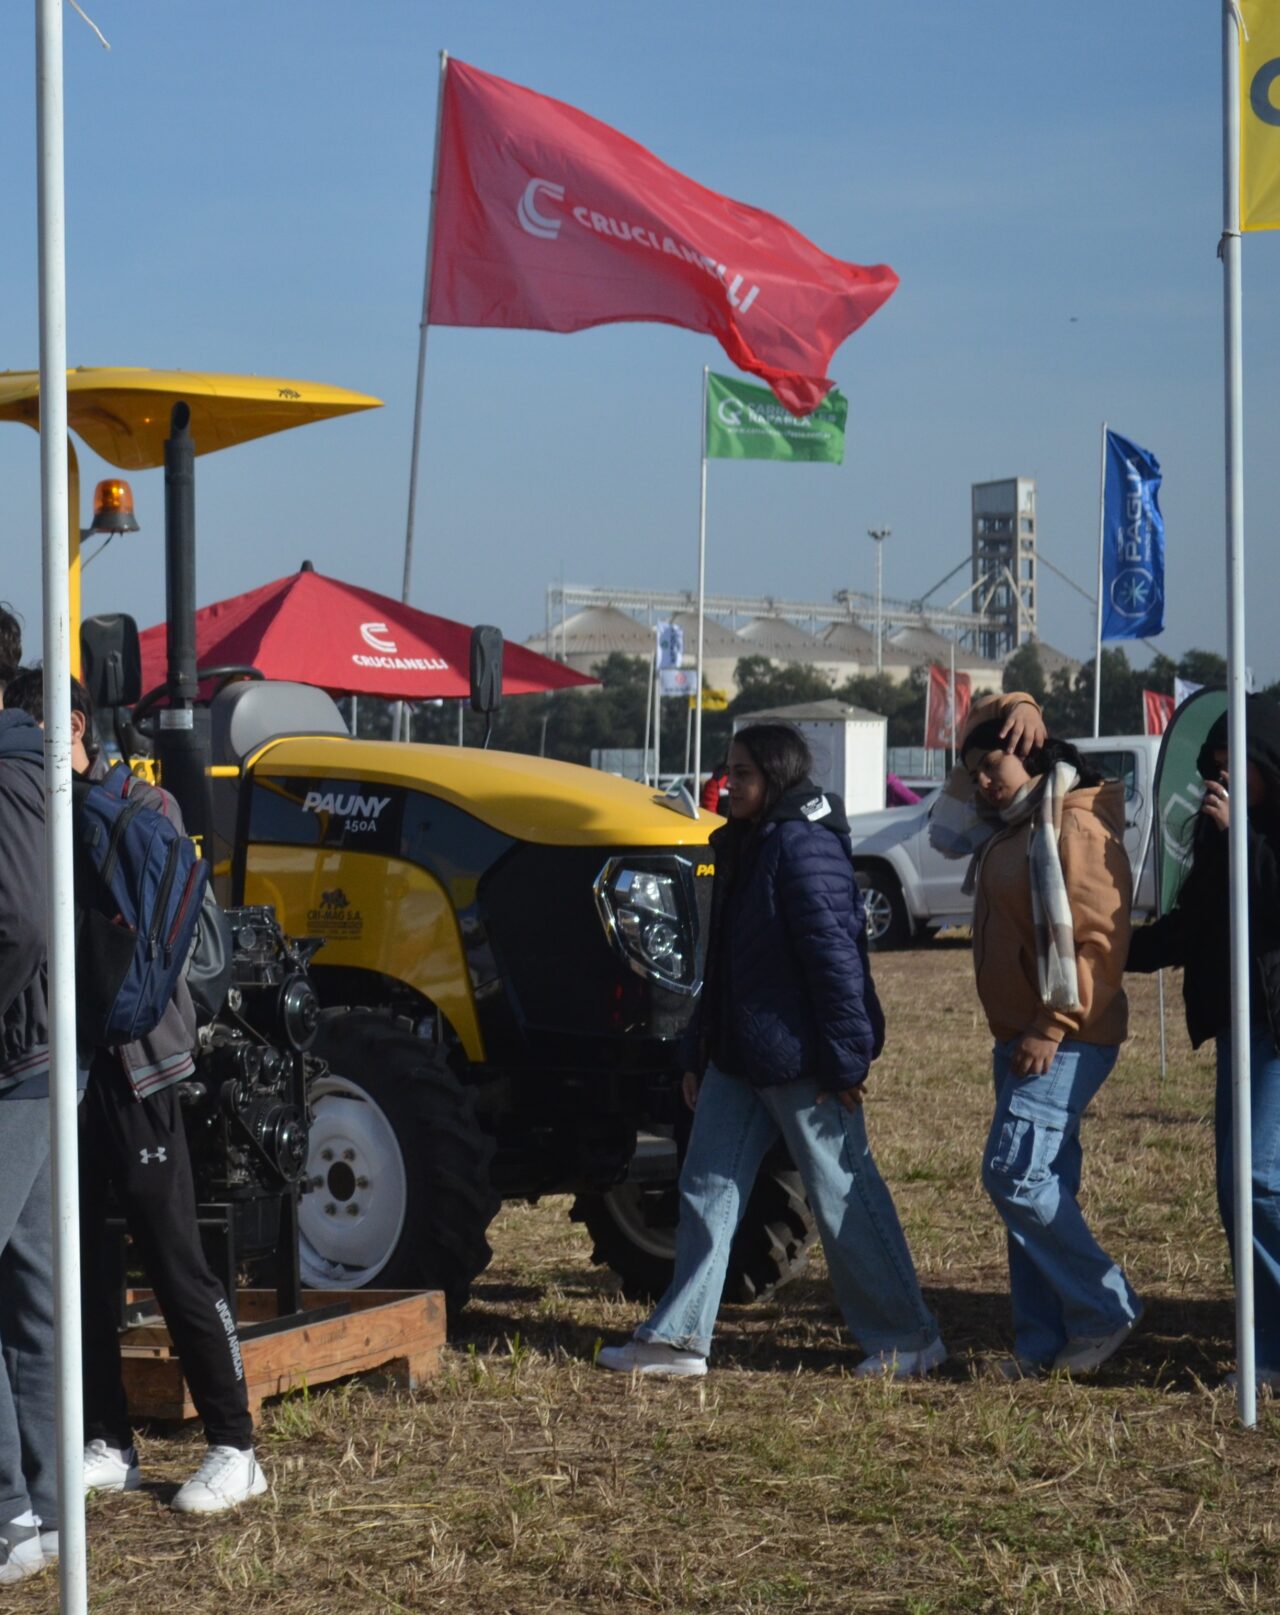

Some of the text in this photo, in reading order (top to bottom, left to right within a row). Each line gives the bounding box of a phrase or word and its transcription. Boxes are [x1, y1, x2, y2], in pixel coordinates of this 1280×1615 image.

[352, 654, 449, 670] CRUCIANELLI
[302, 791, 391, 818] PAUNY
[215, 1298, 243, 1381] UNDER ARMOUR
